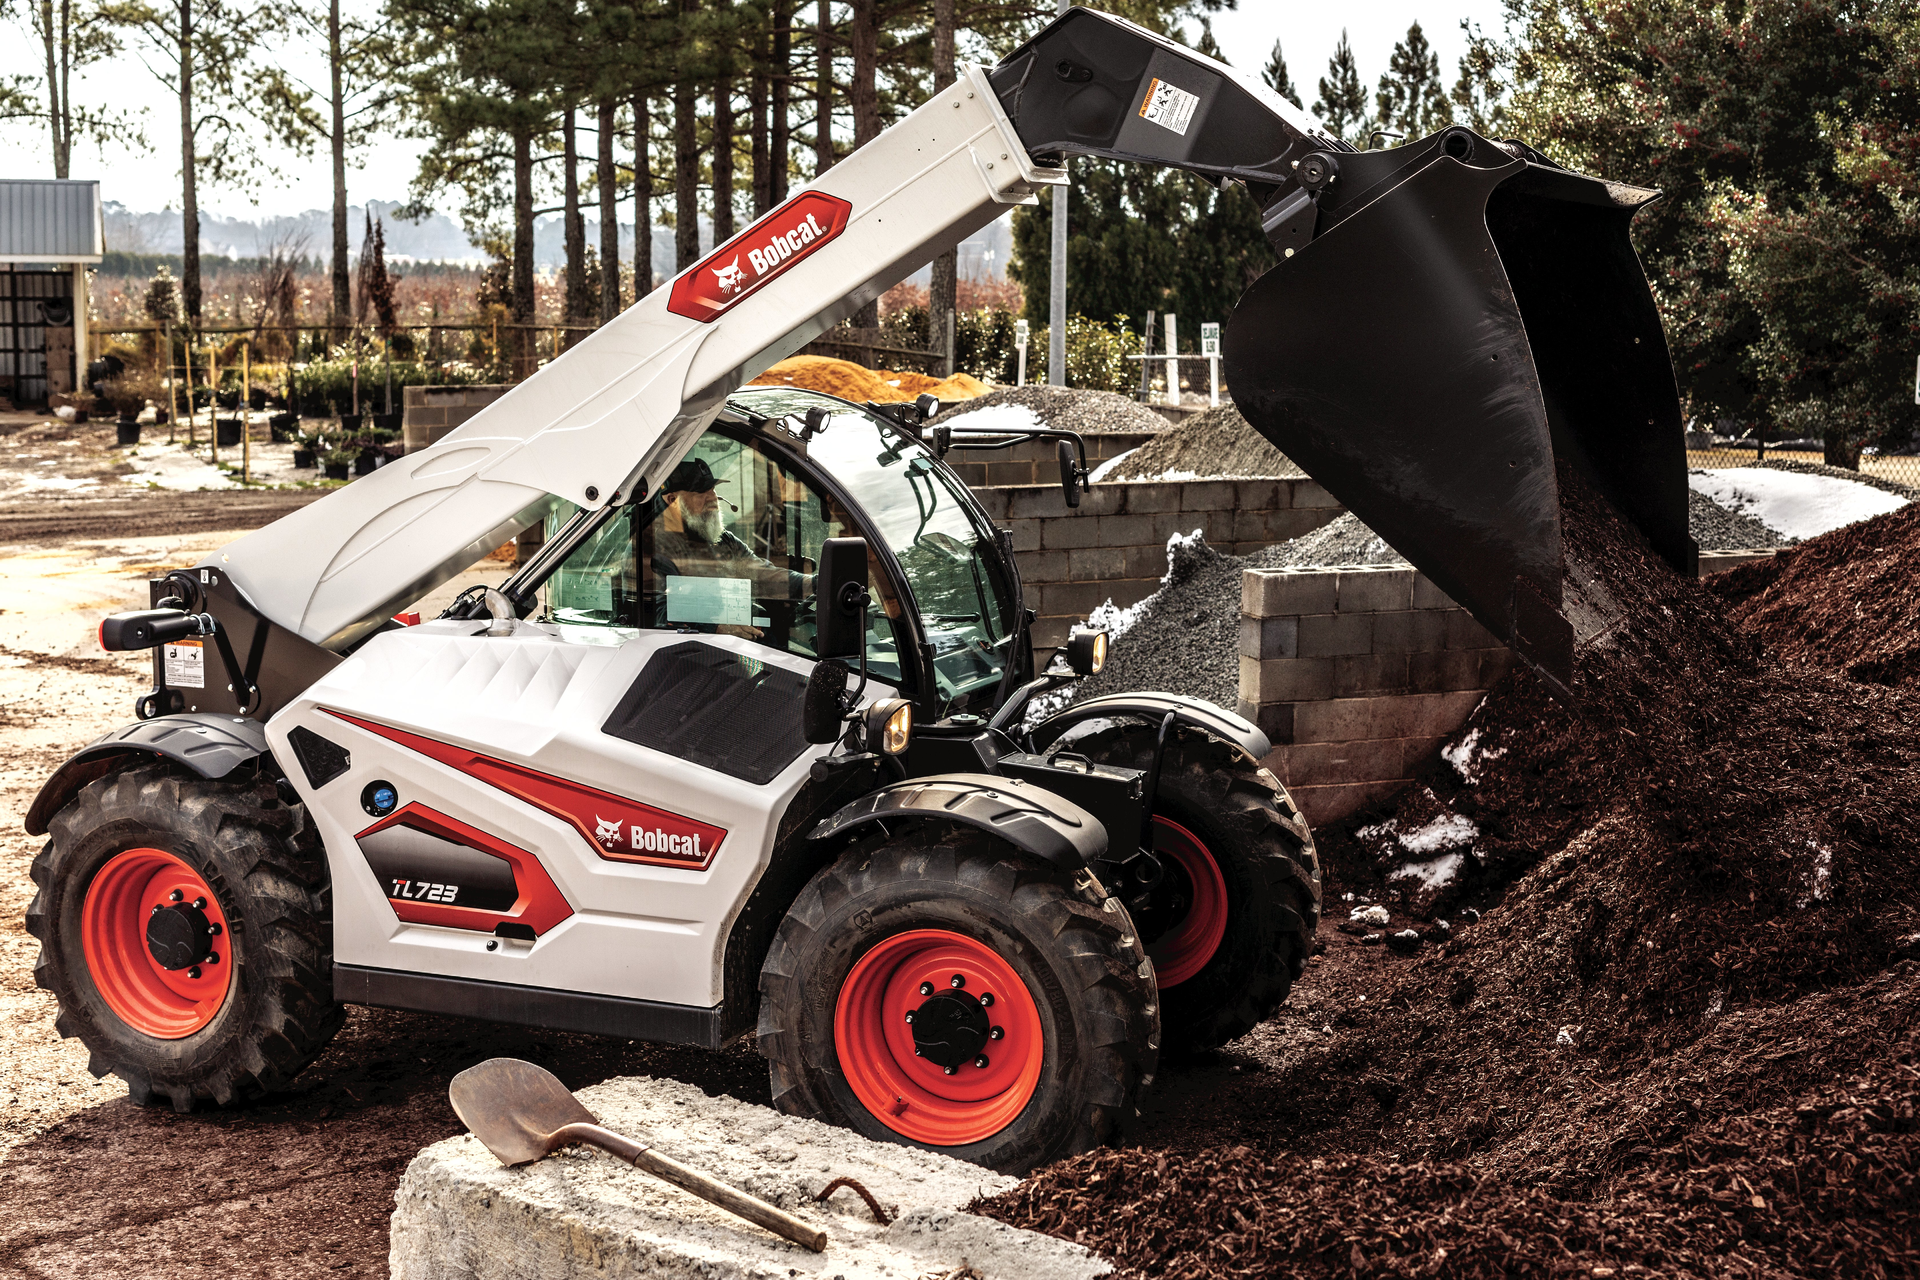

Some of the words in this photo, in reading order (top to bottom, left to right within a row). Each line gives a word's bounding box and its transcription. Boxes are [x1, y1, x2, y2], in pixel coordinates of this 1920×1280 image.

[1143, 81, 1158, 107] WARNING
[748, 213, 822, 276] Bobcat
[630, 825, 702, 857] Bobcat
[392, 879, 458, 903] TL723
